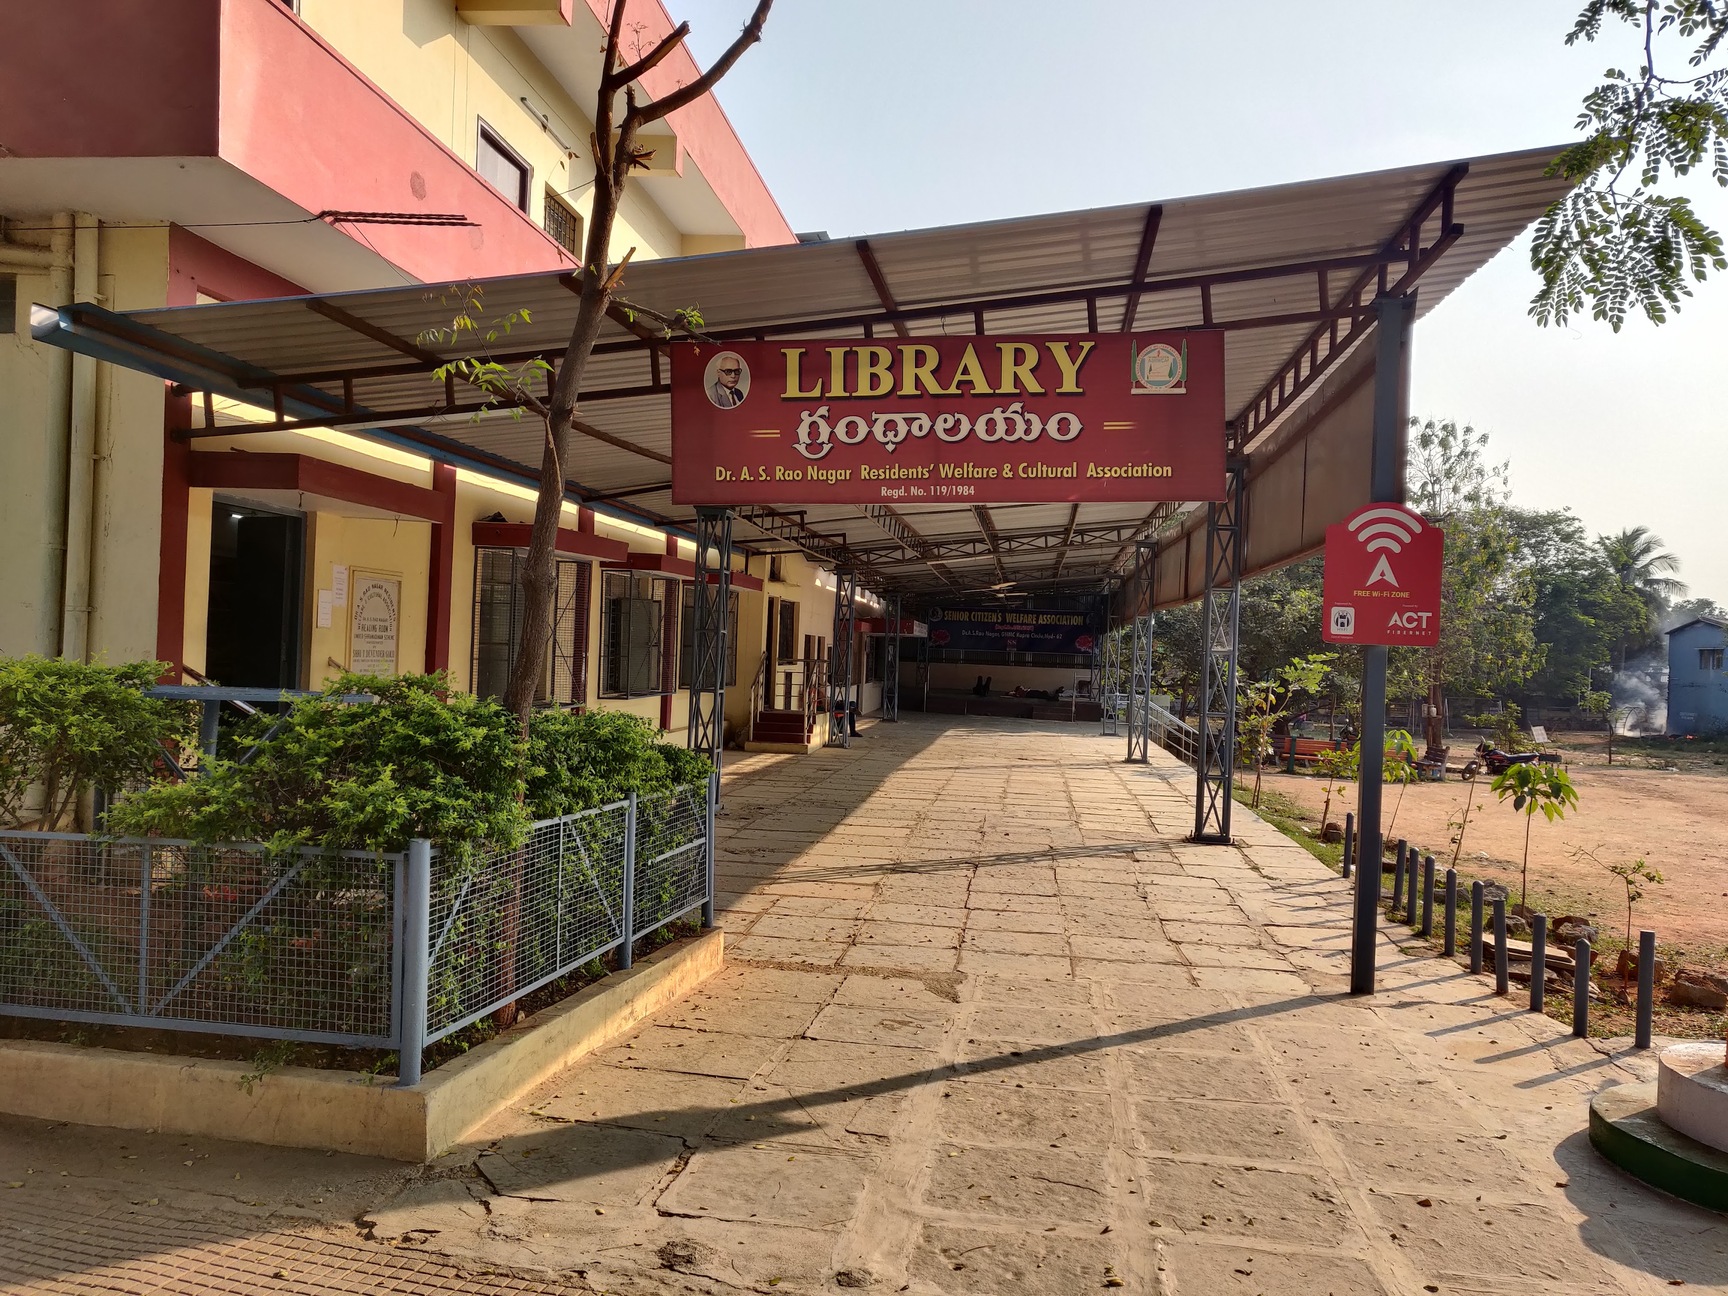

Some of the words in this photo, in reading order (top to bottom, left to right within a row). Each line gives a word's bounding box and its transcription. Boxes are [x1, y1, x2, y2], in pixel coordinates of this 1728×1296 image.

[780, 341, 1096, 399] LIBRARY
[715, 465, 736, 482] Dr.
[740, 465, 755, 481] A.
[758, 465, 771, 481] S.
[775, 465, 803, 481] Rao
[807, 465, 852, 484] Nagar
[939, 462, 998, 478] Welfare
[1002, 462, 1014, 478] &
[1018, 461, 1077, 478] Cultural
[1086, 462, 1172, 478] Association
[881, 486, 908, 498] Regd.
[910, 485, 927, 496] No.
[930, 485, 975, 496] 119/1984
[944, 610, 969, 621] SENIOR
[1006, 612, 1037, 624] WELFARE
[1038, 613, 1084, 625] ASSOCIATION
[1387, 611, 1433, 629] ACT
